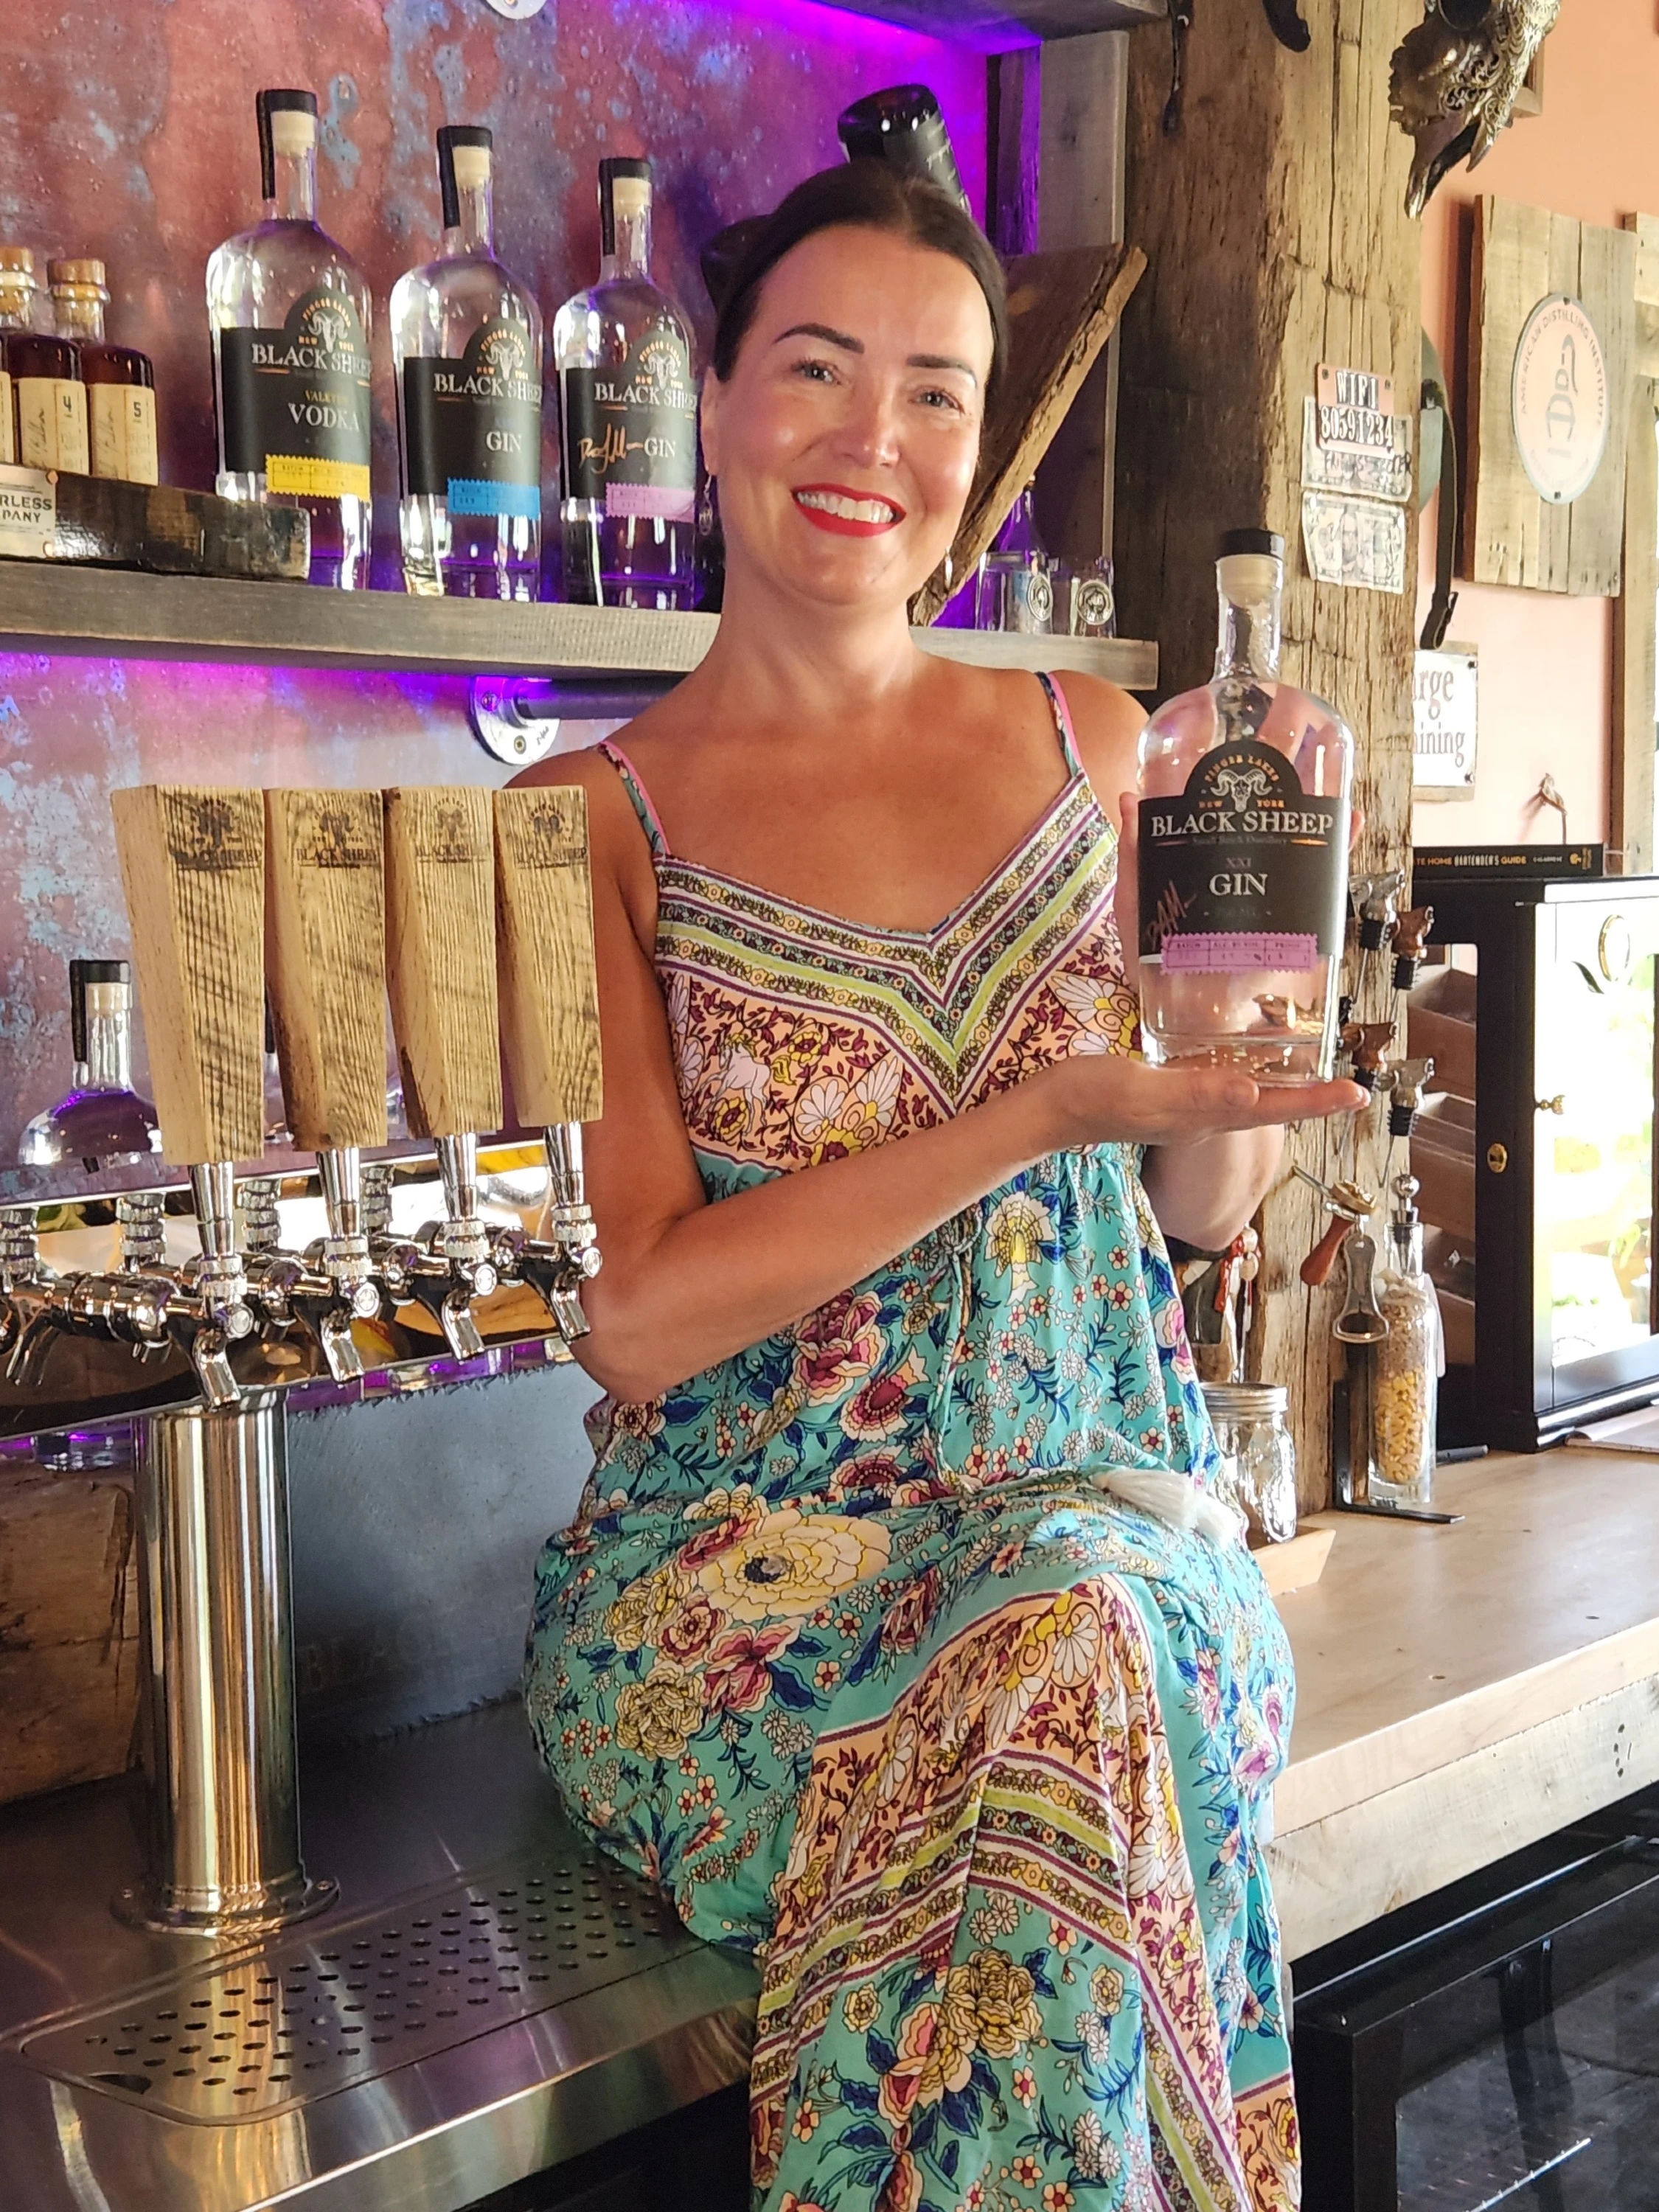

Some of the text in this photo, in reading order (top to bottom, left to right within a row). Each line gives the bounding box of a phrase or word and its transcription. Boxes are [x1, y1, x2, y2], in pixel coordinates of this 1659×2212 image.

[251, 342, 328, 370] BLACK
[1520, 307, 1604, 430] AMERICAN DISTILLING INSTITUTE
[433, 373, 504, 398] BLACK
[594, 382, 661, 405] BLACK
[1336, 371, 1377, 409] WIFI
[63, 395, 72, 413] 4
[133, 401, 142, 418] 5
[288, 402, 360, 433] VODKA
[1320, 406, 1394, 448] 80591234
[486, 430, 522, 454] GIN
[644, 437, 676, 458] GIN
[0, 493, 53, 511] RLESS
[2, 509, 41, 523] PANY
[1204, 754, 1244, 783] FINGER
[1198, 799, 1285, 809] NEW YORK
[1151, 810, 1334, 837] BLACK SHEEP
[1225, 858, 1252, 868] XXI
[1427, 857, 1453, 865] HOME
[1500, 855, 1527, 865] GUIDE
[1208, 873, 1269, 897] GIN
